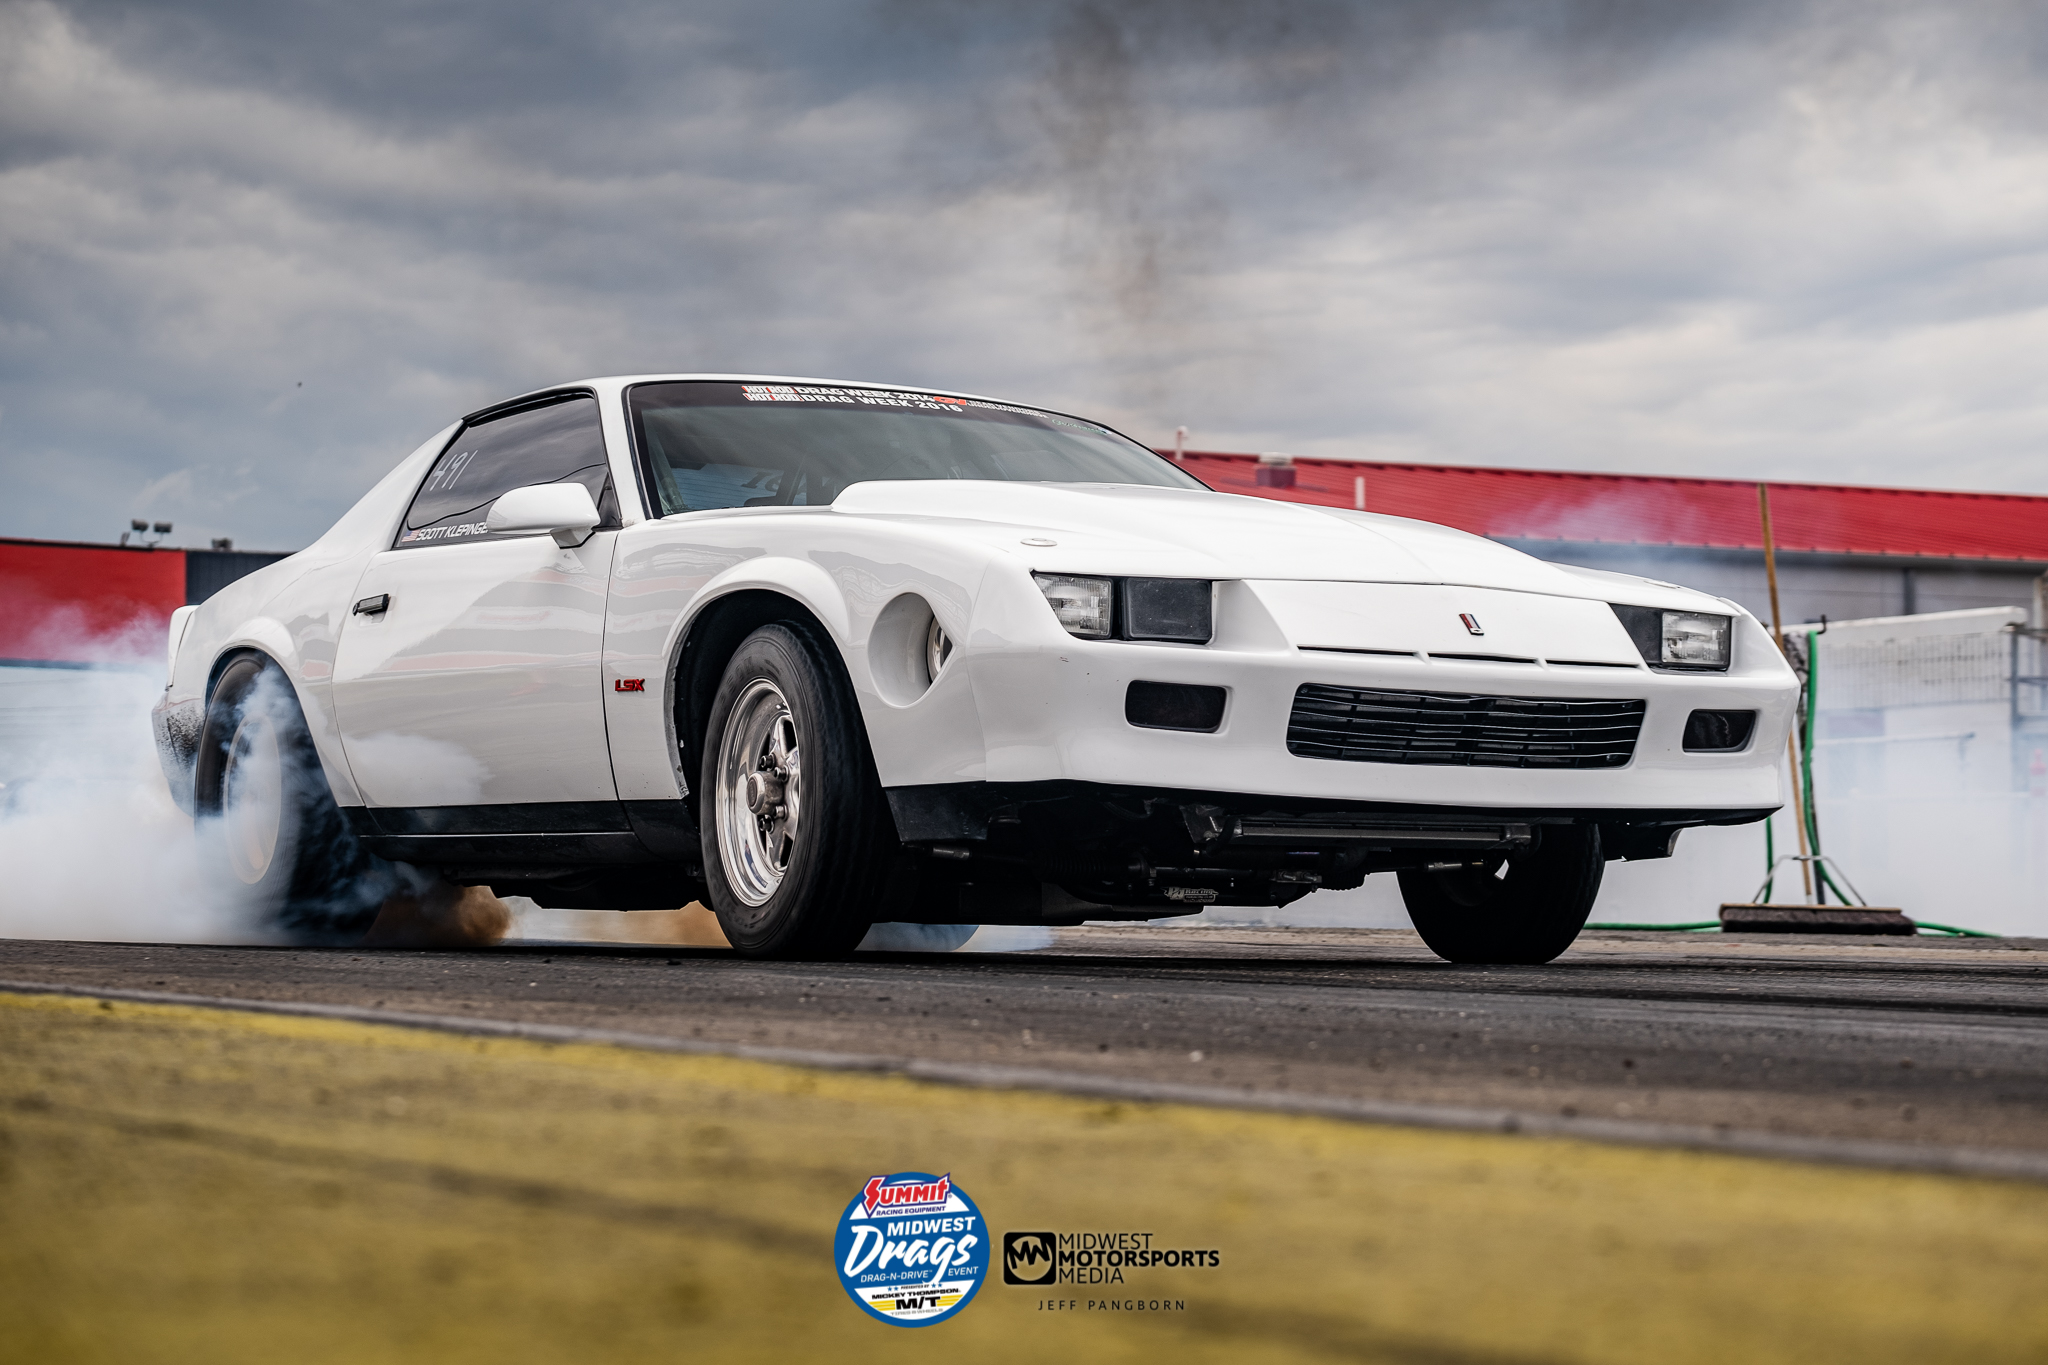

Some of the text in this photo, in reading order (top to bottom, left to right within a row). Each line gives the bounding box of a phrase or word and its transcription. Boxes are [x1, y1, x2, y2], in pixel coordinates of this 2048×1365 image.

[793, 387, 845, 396] DRAG
[842, 389, 896, 399] WEEK
[800, 395, 855, 404] DRAG
[856, 397, 914, 407] WEEK
[915, 401, 963, 412] 2016
[429, 450, 478, 492] 491
[416, 526, 448, 541] SCOTT
[615, 679, 645, 692] LSX
